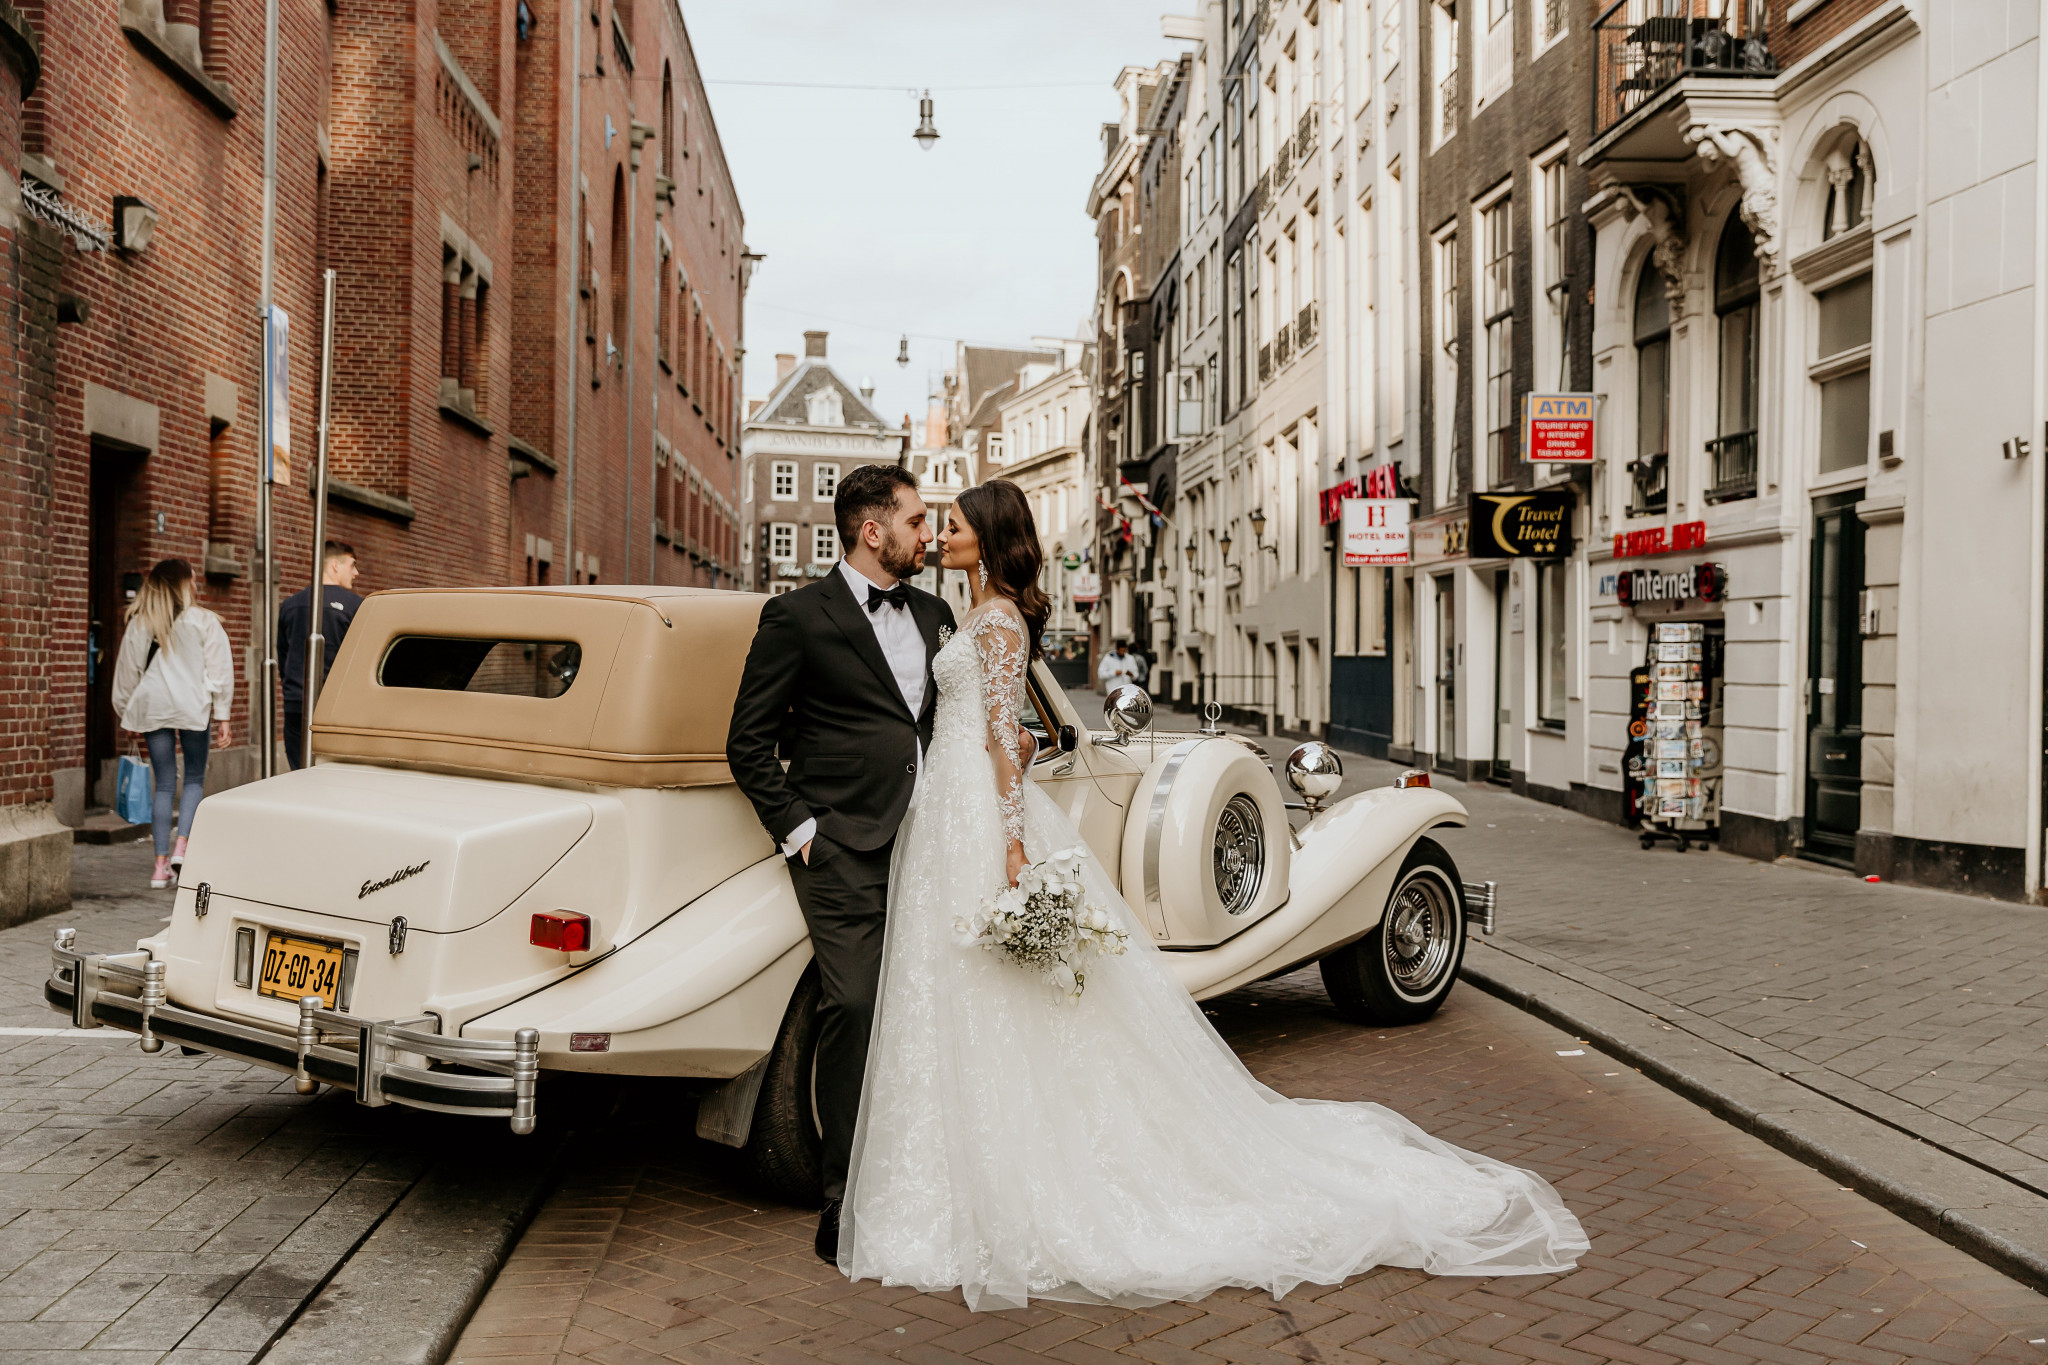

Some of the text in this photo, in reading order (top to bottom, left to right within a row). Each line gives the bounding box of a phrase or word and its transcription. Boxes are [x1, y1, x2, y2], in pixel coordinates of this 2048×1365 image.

[1538, 401, 1587, 415] ATM
[1535, 422, 1589, 430] TOURIST INFO
[1547, 431, 1585, 439] INTERNET
[1546, 440, 1576, 448] DRINKS
[1564, 449, 1586, 457] SHOP
[1518, 505, 1565, 522] Travel
[1518, 523, 1560, 541] Hotel
[1632, 565, 1696, 601] Internet
[358, 860, 430, 900] Excalibur
[264, 948, 336, 995] DZ-GD-34
